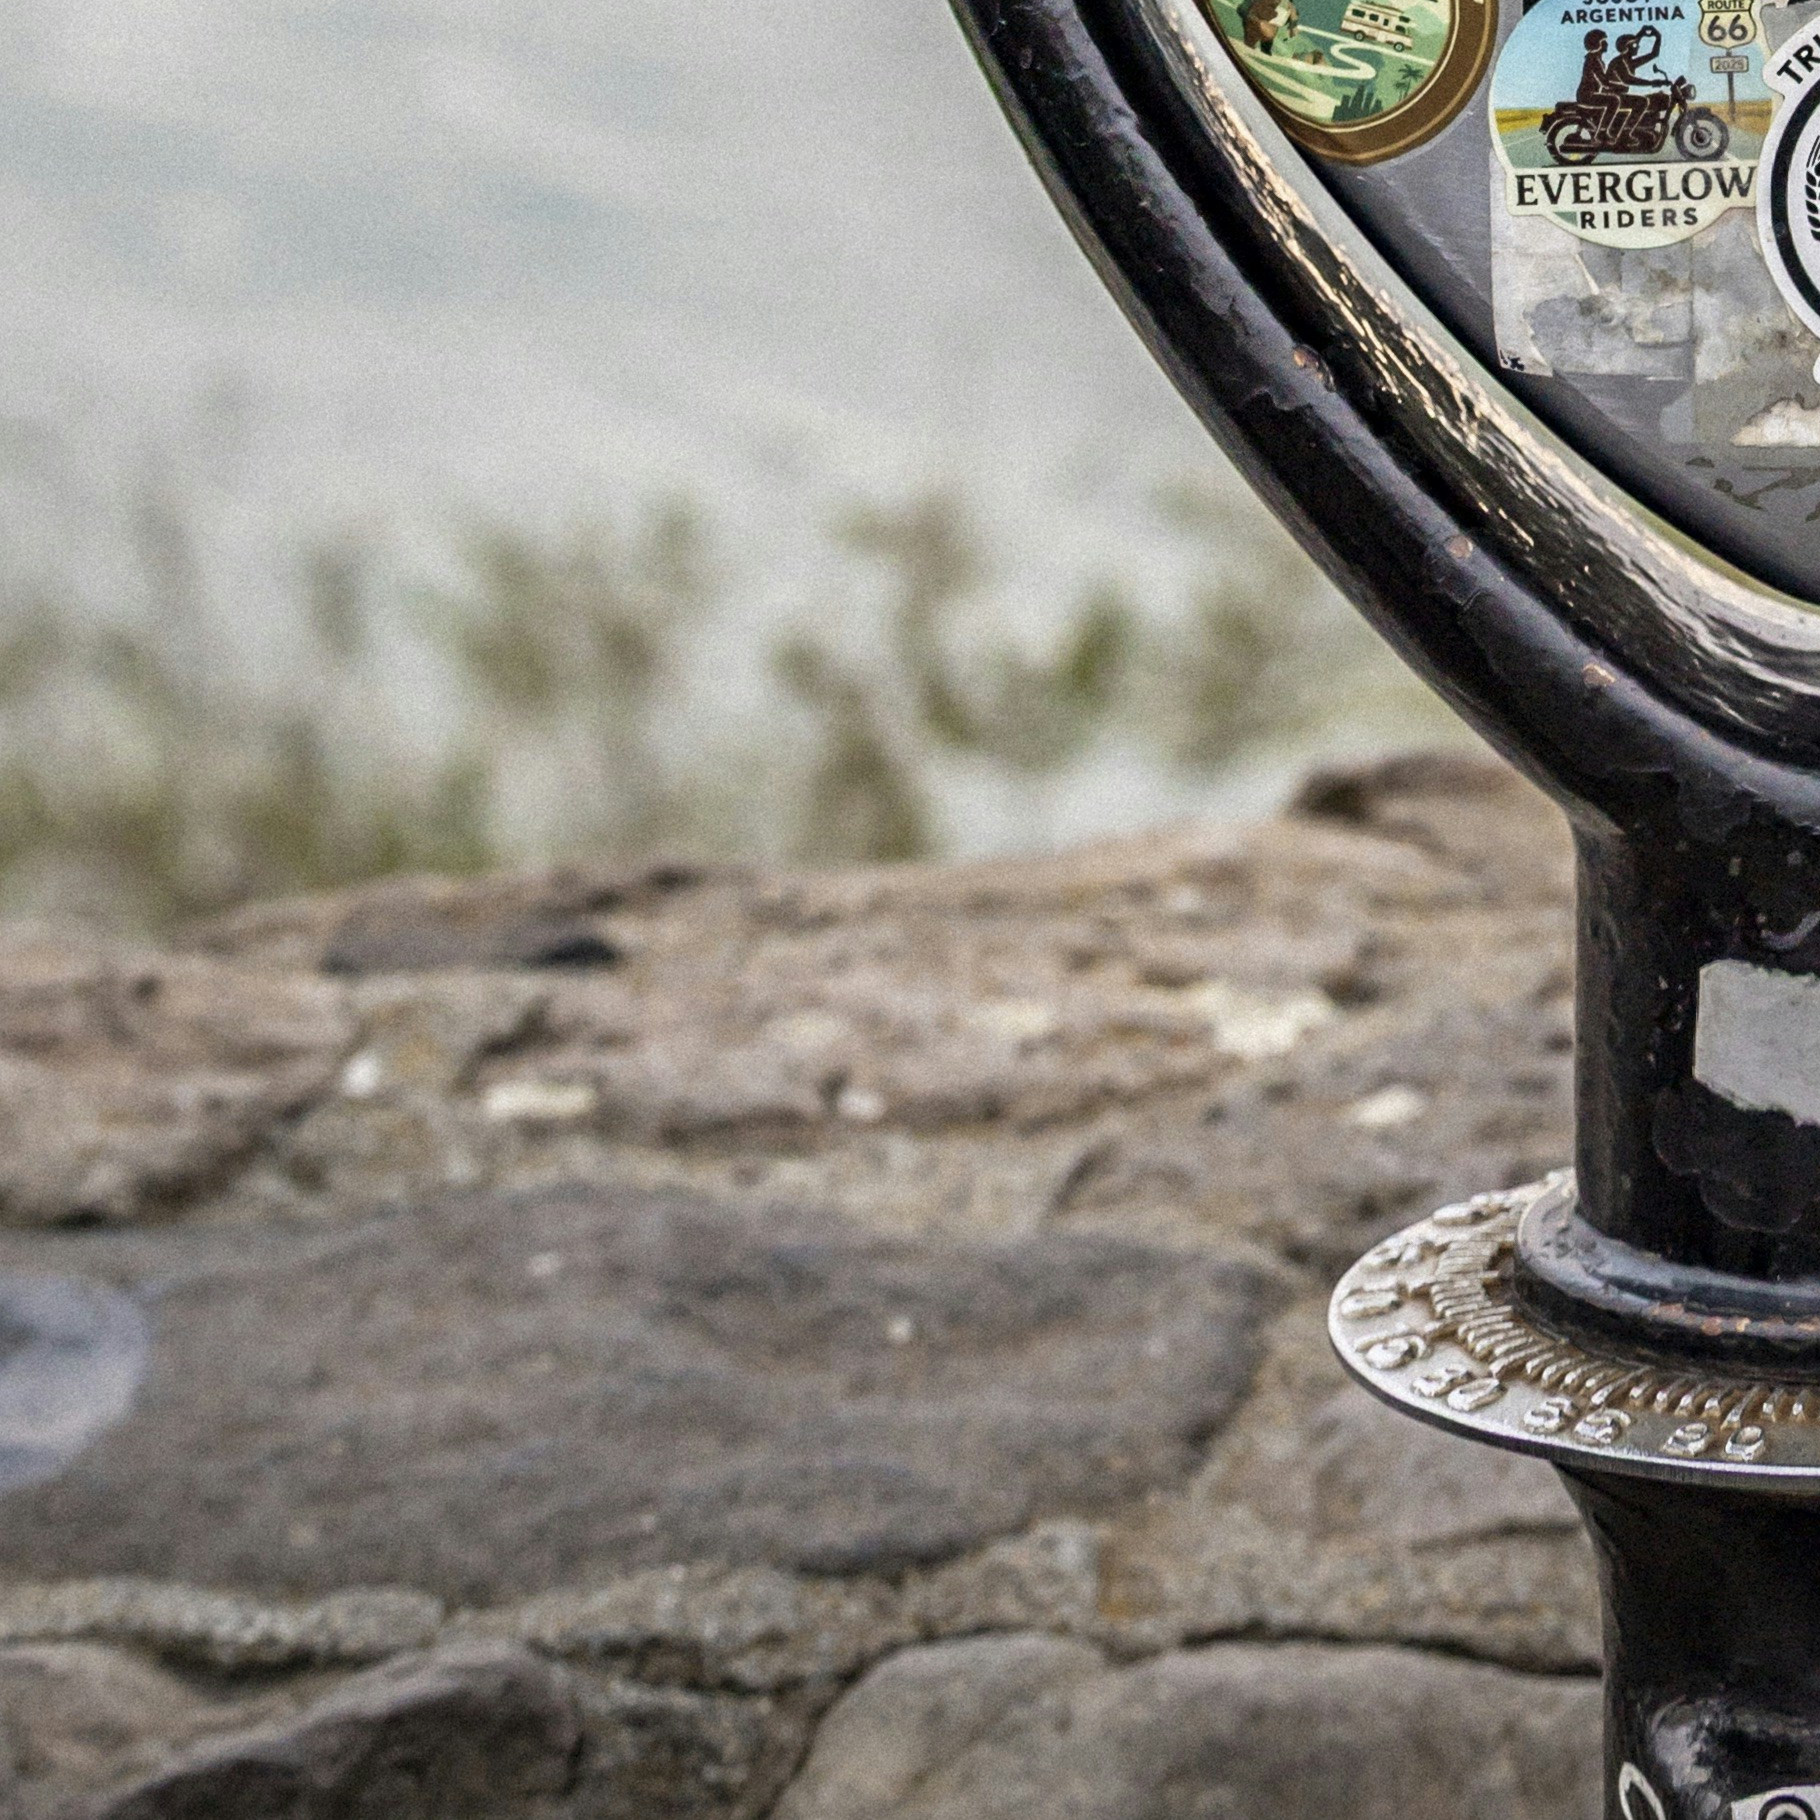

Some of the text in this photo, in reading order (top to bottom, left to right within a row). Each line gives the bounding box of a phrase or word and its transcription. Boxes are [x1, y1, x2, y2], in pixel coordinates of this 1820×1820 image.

[1561, 6, 1685, 24] ARGENTINA
[1708, 0, 1745, 10] ROUTE
[1708, 14, 1748, 41] 66
[1515, 164, 1758, 207] EVERGLOW
[1580, 208, 1698, 229] RIDERS
